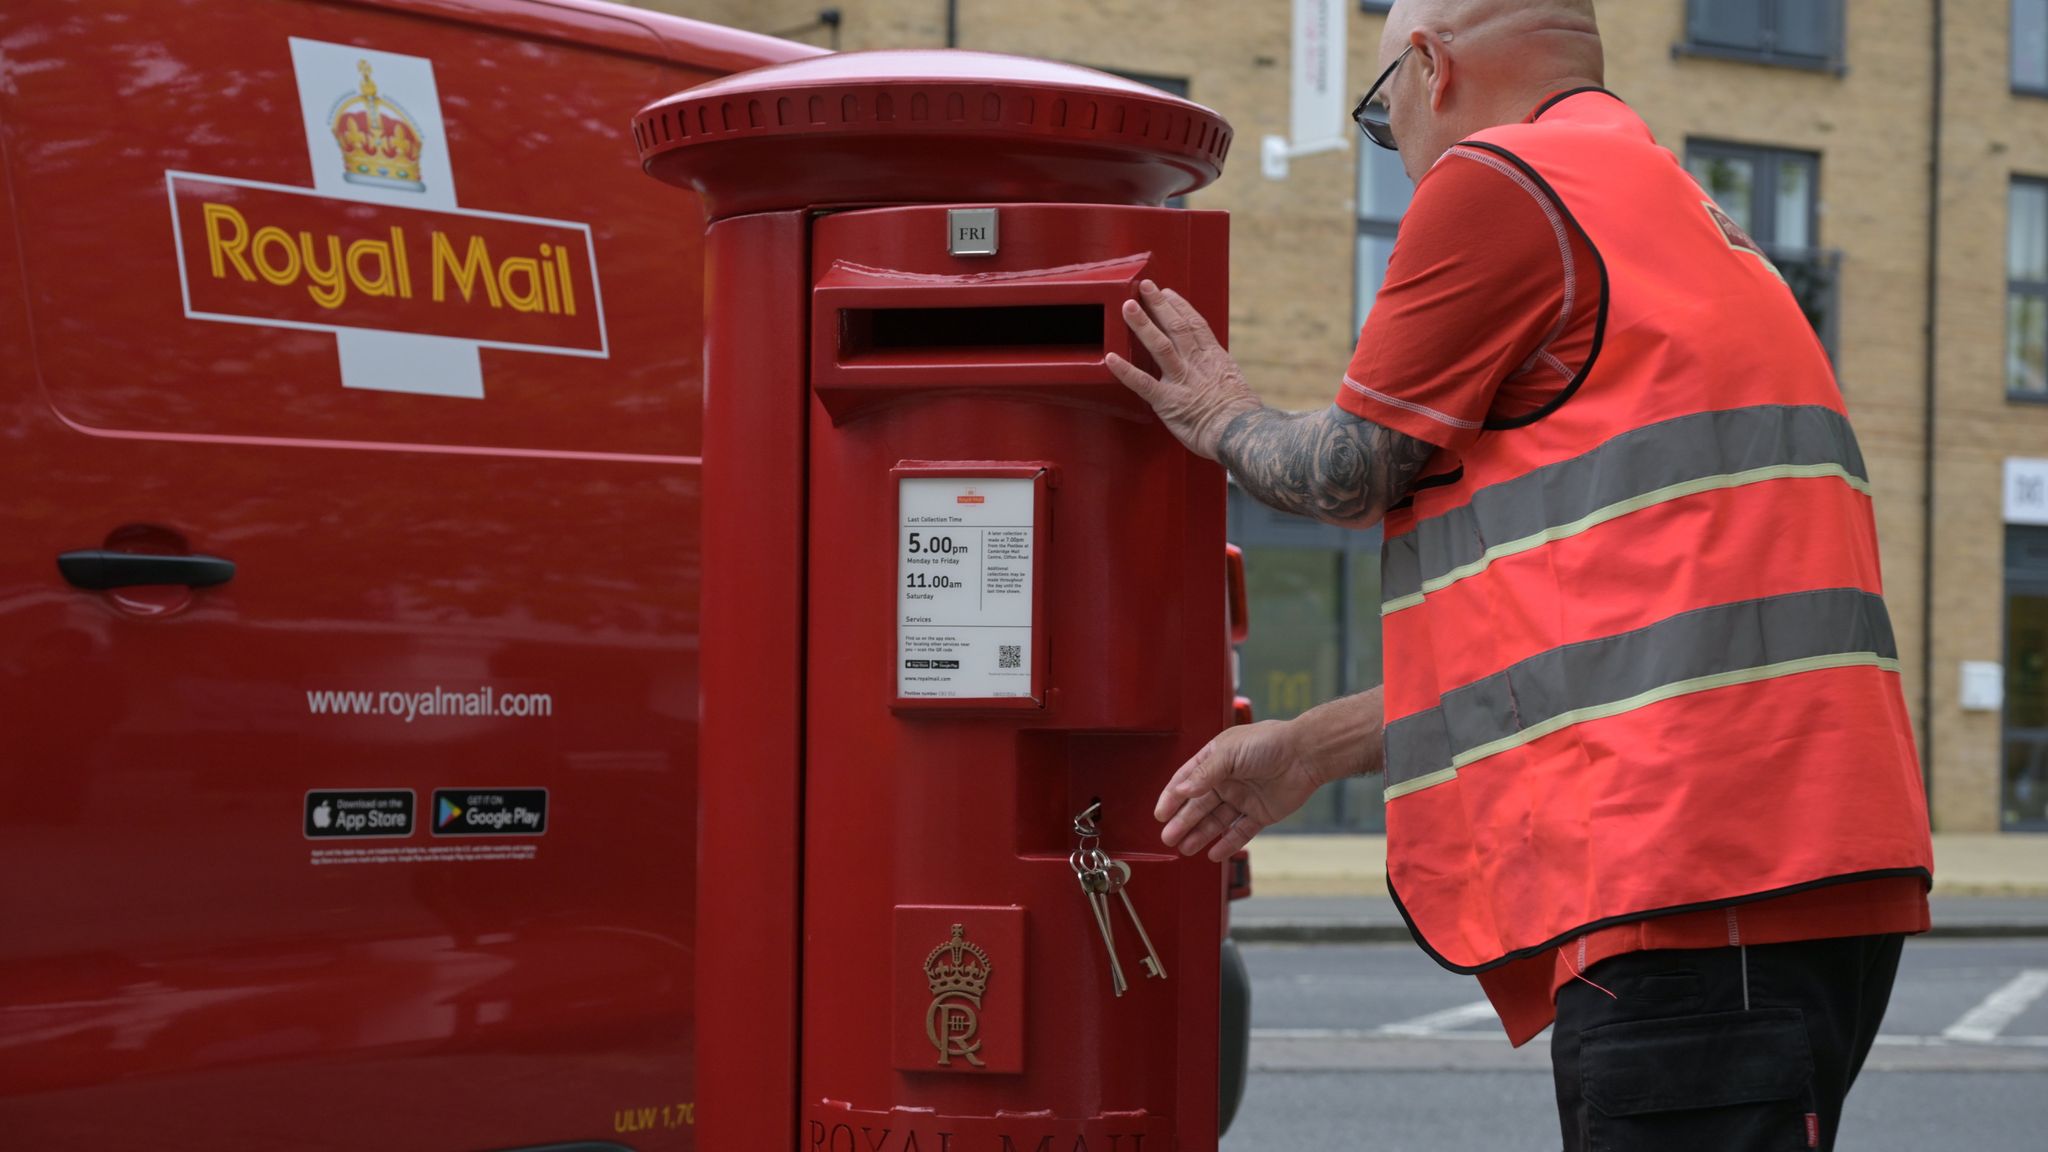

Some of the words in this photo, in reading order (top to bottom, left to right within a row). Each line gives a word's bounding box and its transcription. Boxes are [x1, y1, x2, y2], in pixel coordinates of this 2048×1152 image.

[960, 227, 985, 240] FRI
[202, 202, 412, 309] Royal
[431, 230, 576, 316] Mail
[908, 533, 968, 555] 5.00pm
[907, 573, 962, 588] 11.00am
[306, 686, 552, 722] www.royalmail.com
[336, 799, 376, 809] Download
[377, 800, 387, 808] on
[388, 798, 403, 808] the
[335, 810, 367, 831] App
[367, 809, 407, 827] Store
[466, 807, 513, 829] Google
[513, 807, 541, 828] Play
[614, 1107, 658, 1133] ULW
